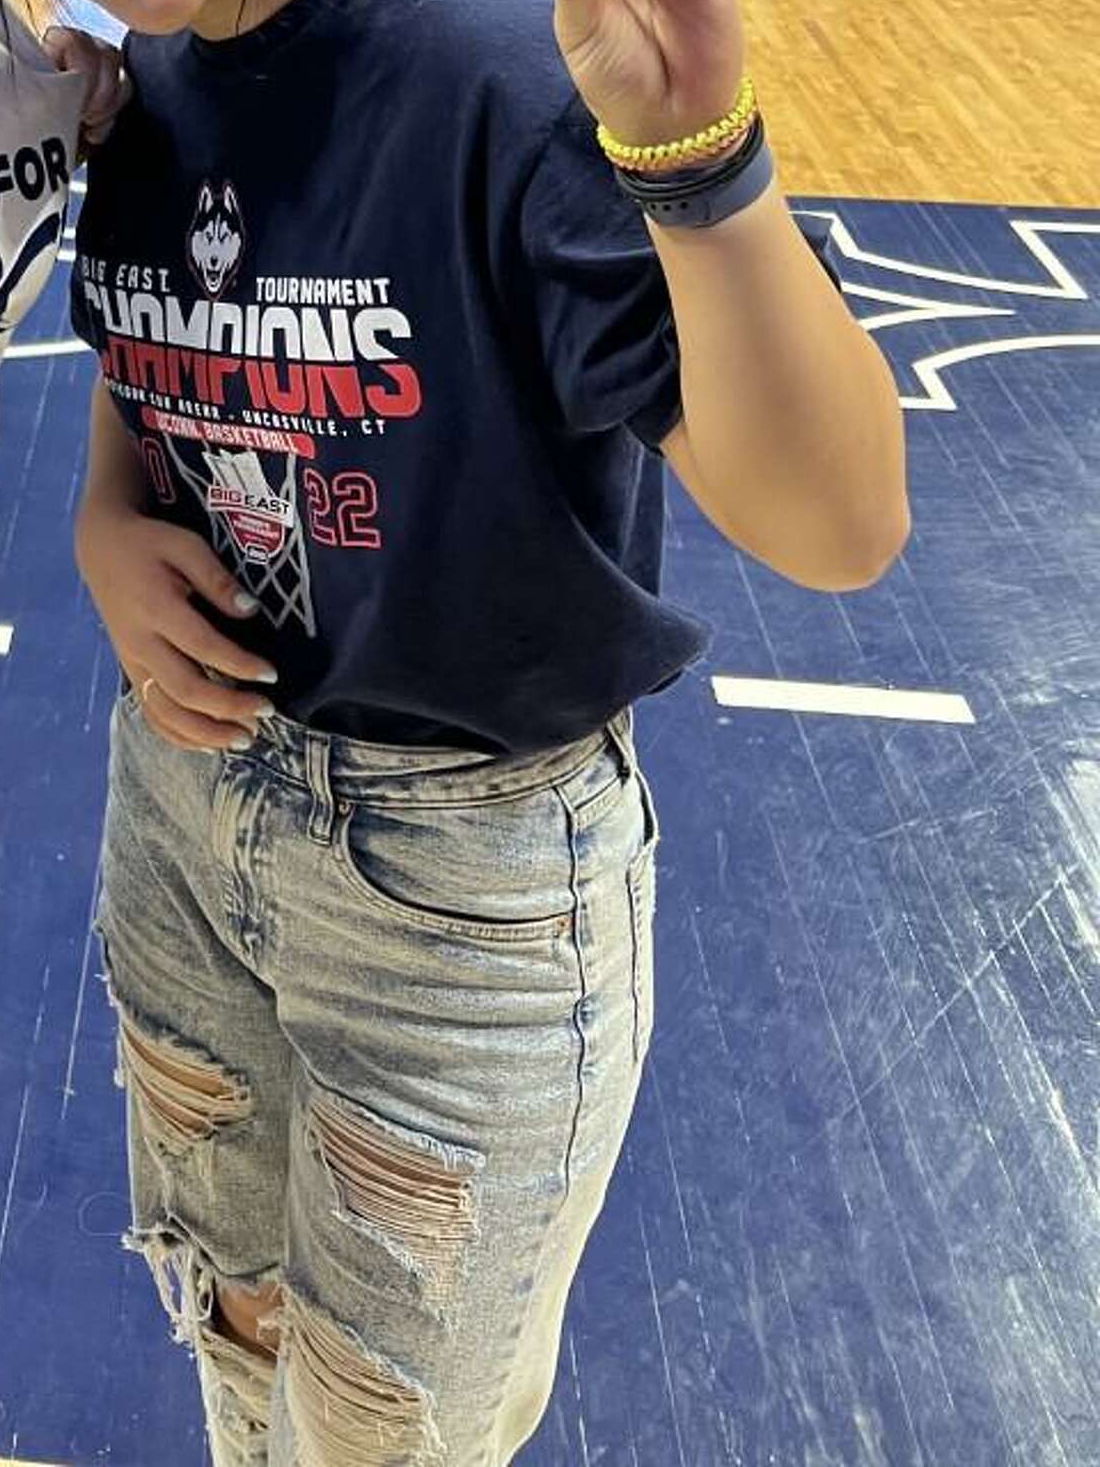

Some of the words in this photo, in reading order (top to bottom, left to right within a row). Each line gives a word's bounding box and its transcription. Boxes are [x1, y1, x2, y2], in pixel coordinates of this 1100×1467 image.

[115, 263, 171, 293] EAST
[255, 276, 390, 307] TOURNAMENT
[203, 419, 299, 454] BASKETBALL
[361, 418, 386, 435] CT
[210, 488, 242, 503] BIG
[244, 495, 290, 514] EAST
